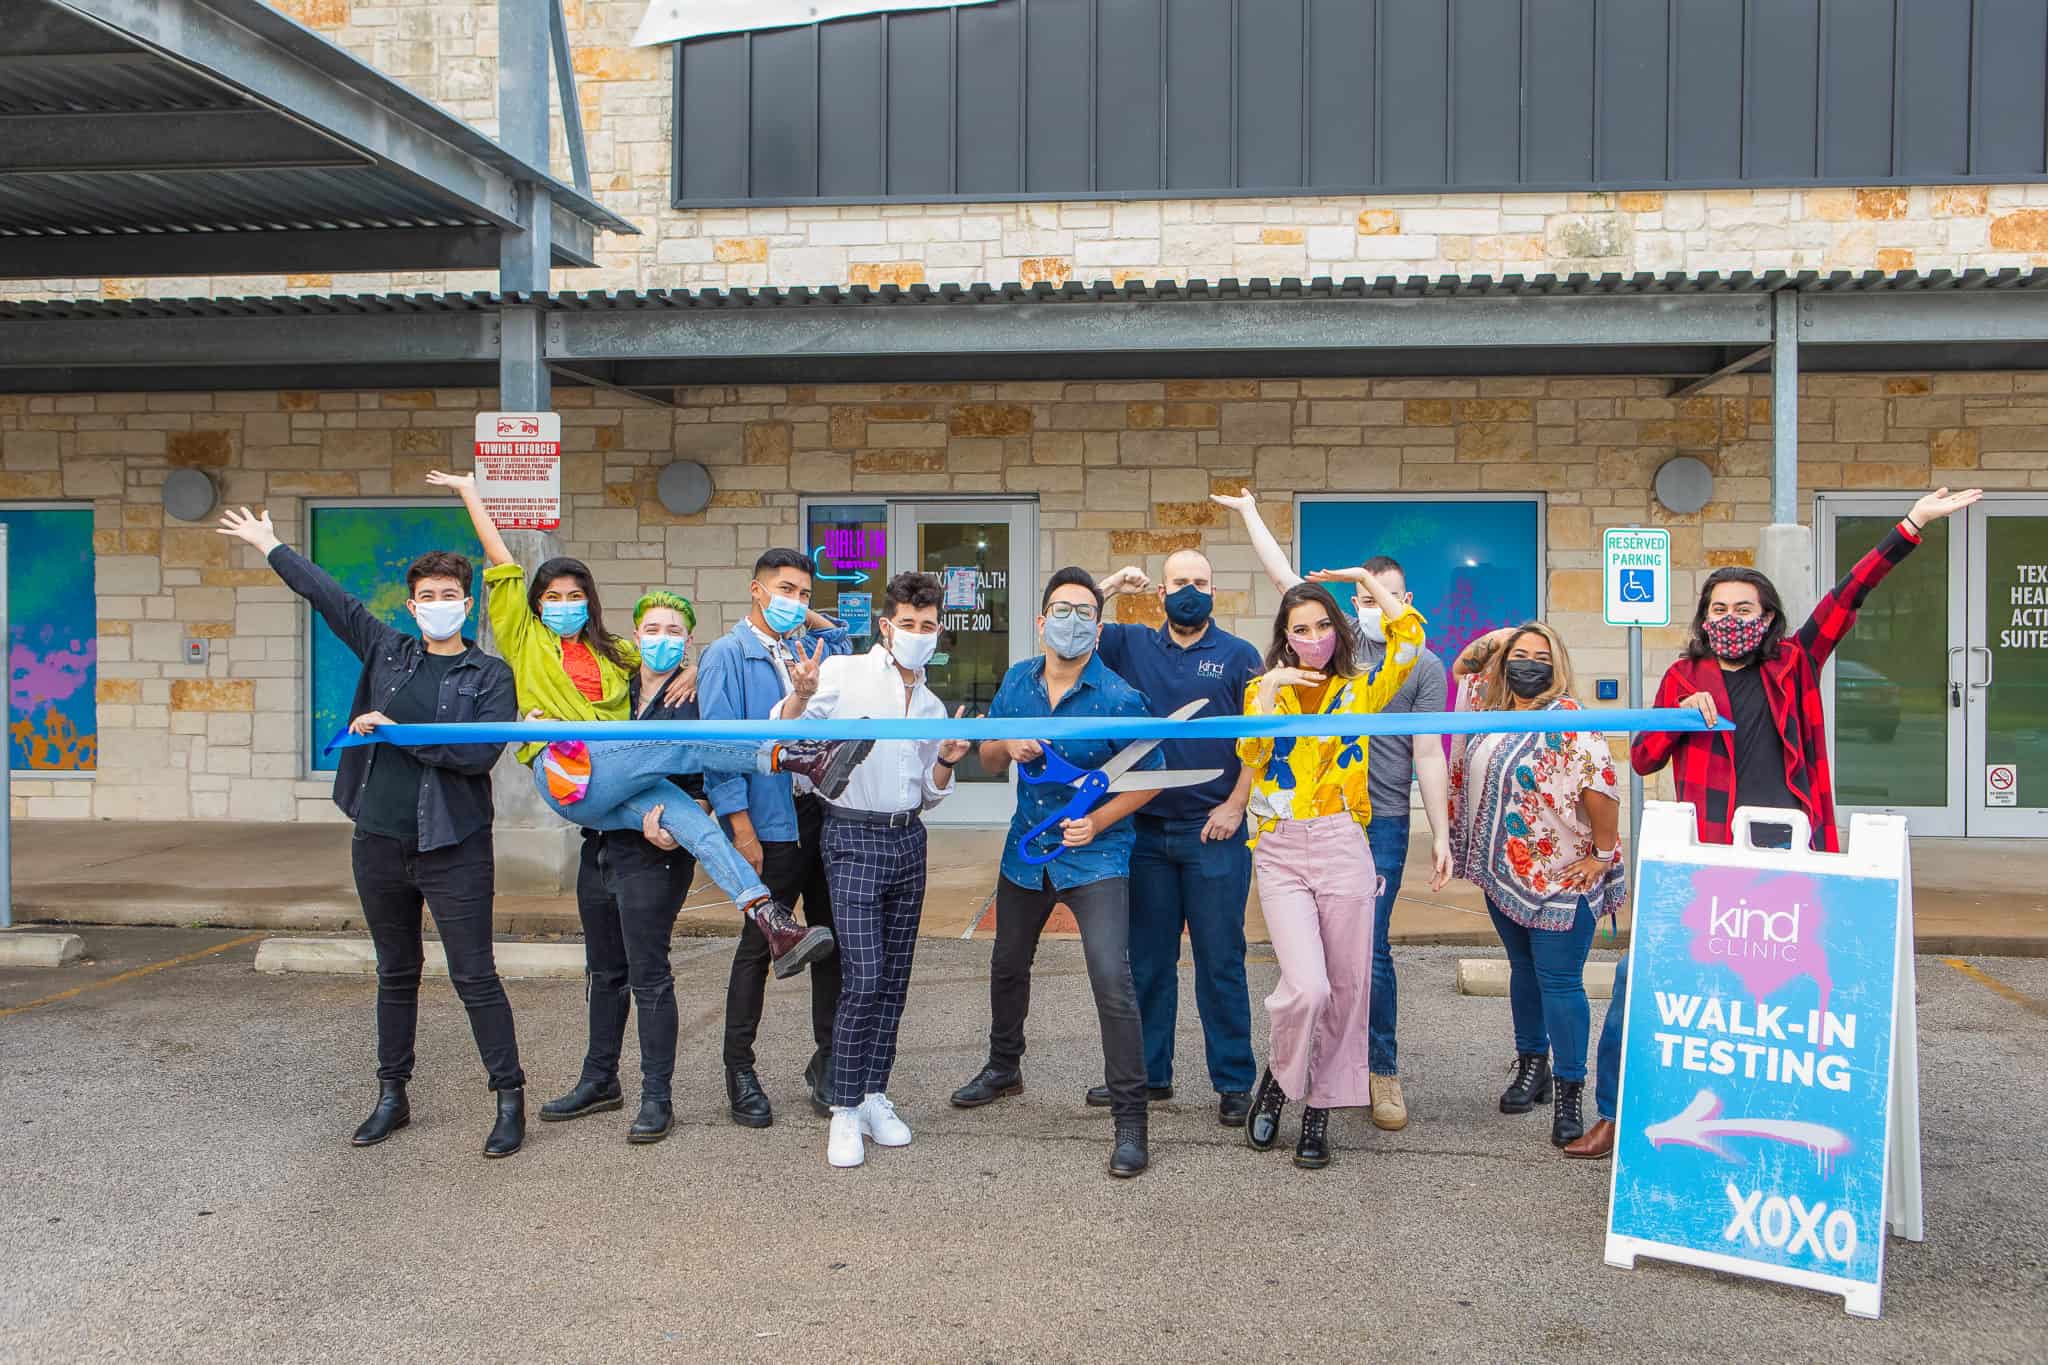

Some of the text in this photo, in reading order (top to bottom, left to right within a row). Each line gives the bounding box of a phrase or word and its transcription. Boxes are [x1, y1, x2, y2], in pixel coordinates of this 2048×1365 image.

[480, 443, 556, 454] TOWING ENFORCED
[825, 528, 886, 559] WALK IN
[1608, 537, 1665, 549] RESERVED
[1612, 553, 1661, 566] PARKING
[2016, 565, 2048, 583] TEX
[972, 614, 991, 631] 200
[2000, 629, 2048, 649] SUITE
[1199, 660, 1224, 673] kind
[1710, 896, 1800, 943] kind
[1709, 938, 1801, 962] CLINIC
[1654, 991, 1857, 1049] WALK-IN
[1654, 1032, 1852, 1092] TESTING
[1724, 1183, 1857, 1263] XOXO
